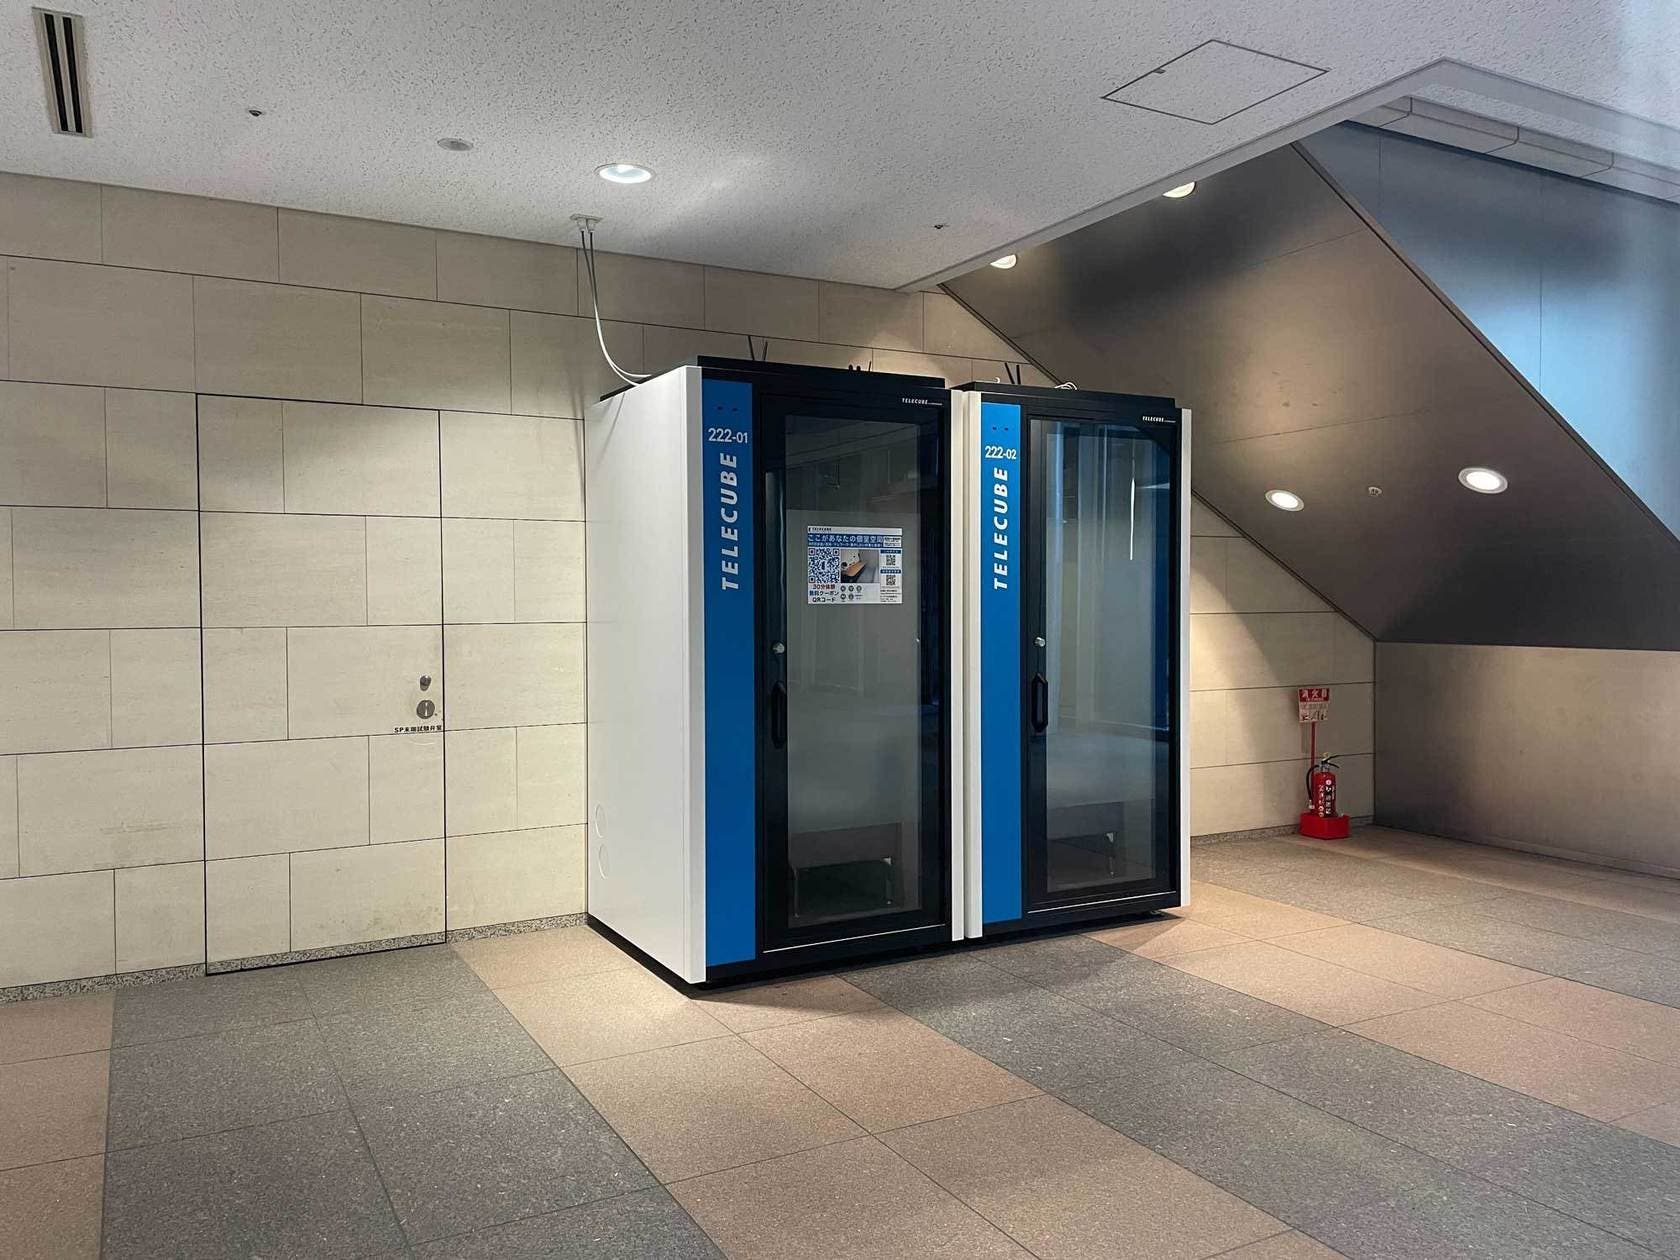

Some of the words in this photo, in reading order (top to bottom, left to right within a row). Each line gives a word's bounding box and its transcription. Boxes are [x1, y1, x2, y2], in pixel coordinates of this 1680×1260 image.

[707, 427, 748, 444] 222-01
[985, 446, 1017, 460] 222-02
[719, 453, 739, 590] TELECUBE
[993, 467, 1008, 590] TELECUBE
